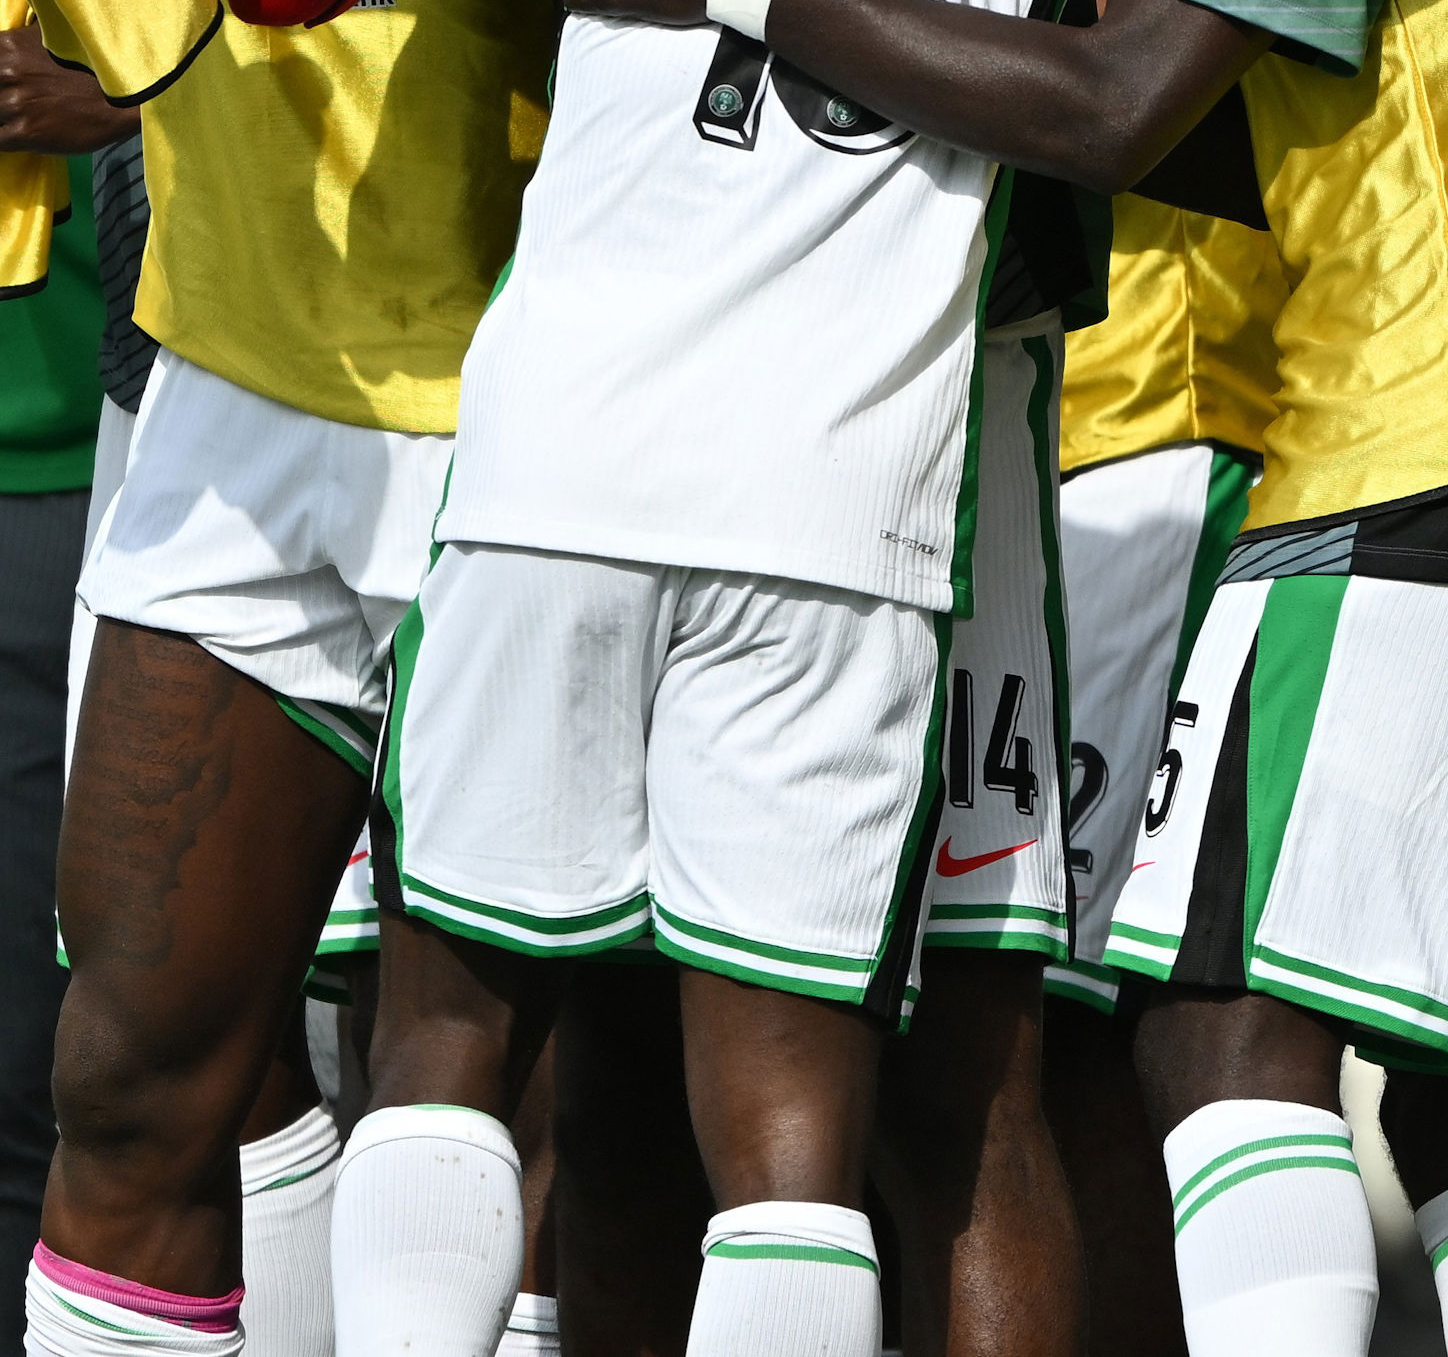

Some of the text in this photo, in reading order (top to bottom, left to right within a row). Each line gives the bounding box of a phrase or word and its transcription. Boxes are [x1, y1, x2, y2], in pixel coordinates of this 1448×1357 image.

[949, 668, 1039, 816] 14
[1068, 741, 1110, 875] 2
[1144, 700, 1200, 838] 5
